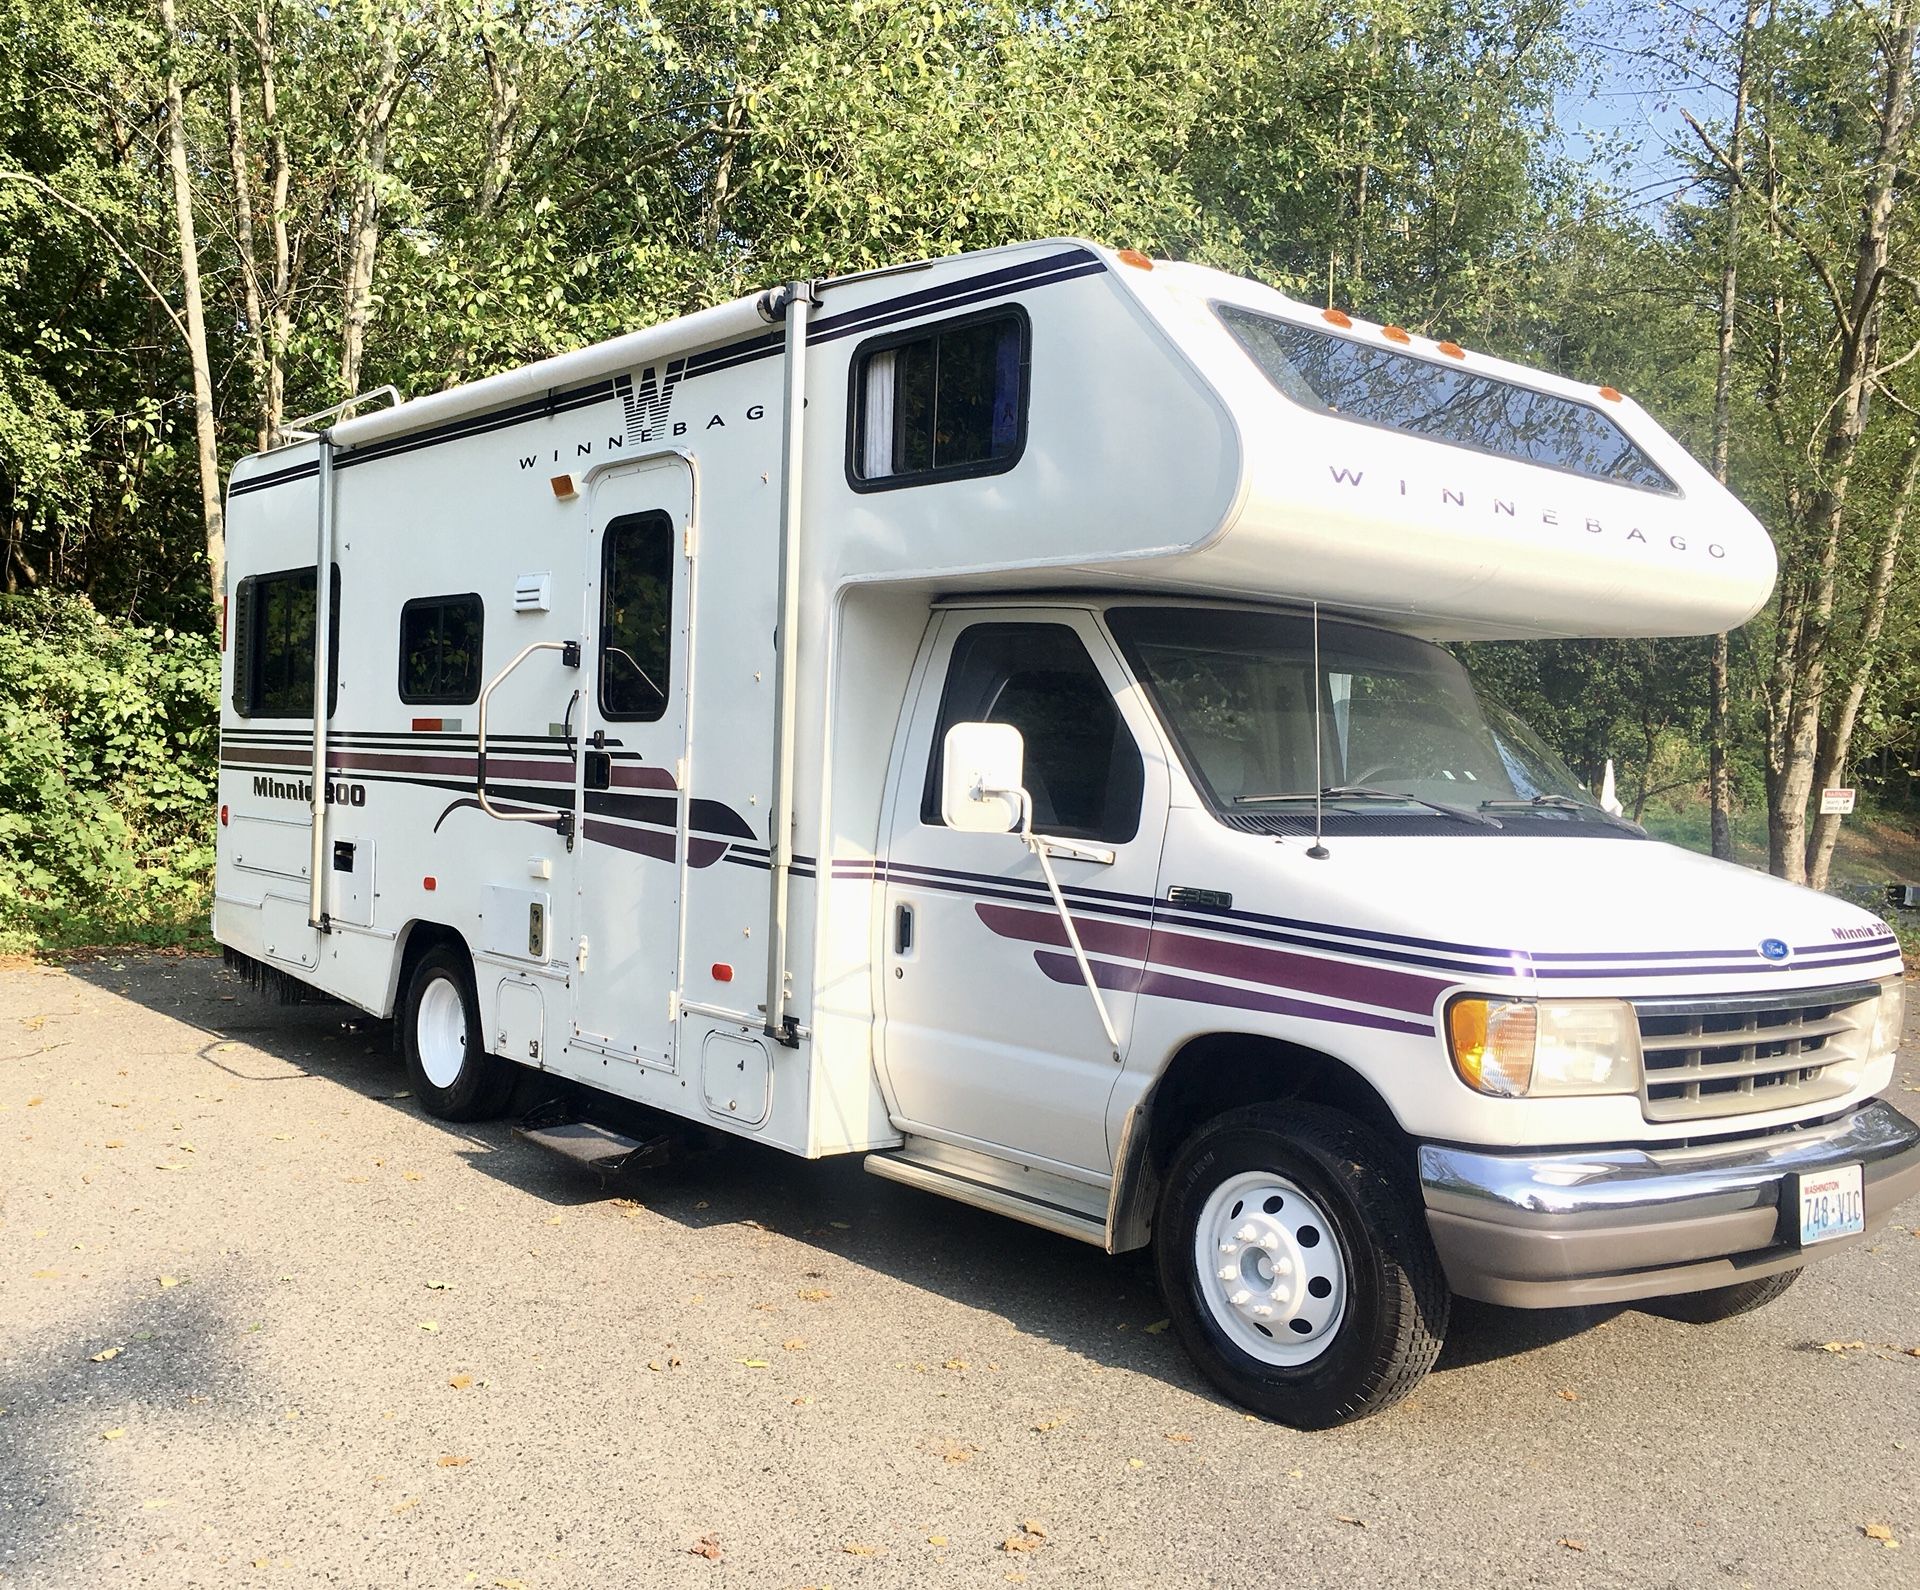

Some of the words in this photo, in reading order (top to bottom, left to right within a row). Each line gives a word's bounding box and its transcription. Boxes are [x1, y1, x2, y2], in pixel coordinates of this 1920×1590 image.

[519, 397, 808, 470] WINNEBAG
[1329, 465, 1725, 559] WINNEBAGO
[1831, 926, 1875, 940] Minnie
[1872, 923, 1892, 935] 300
[1766, 942, 1784, 955] Ford
[1804, 1181, 1839, 1195] WASHINGTON
